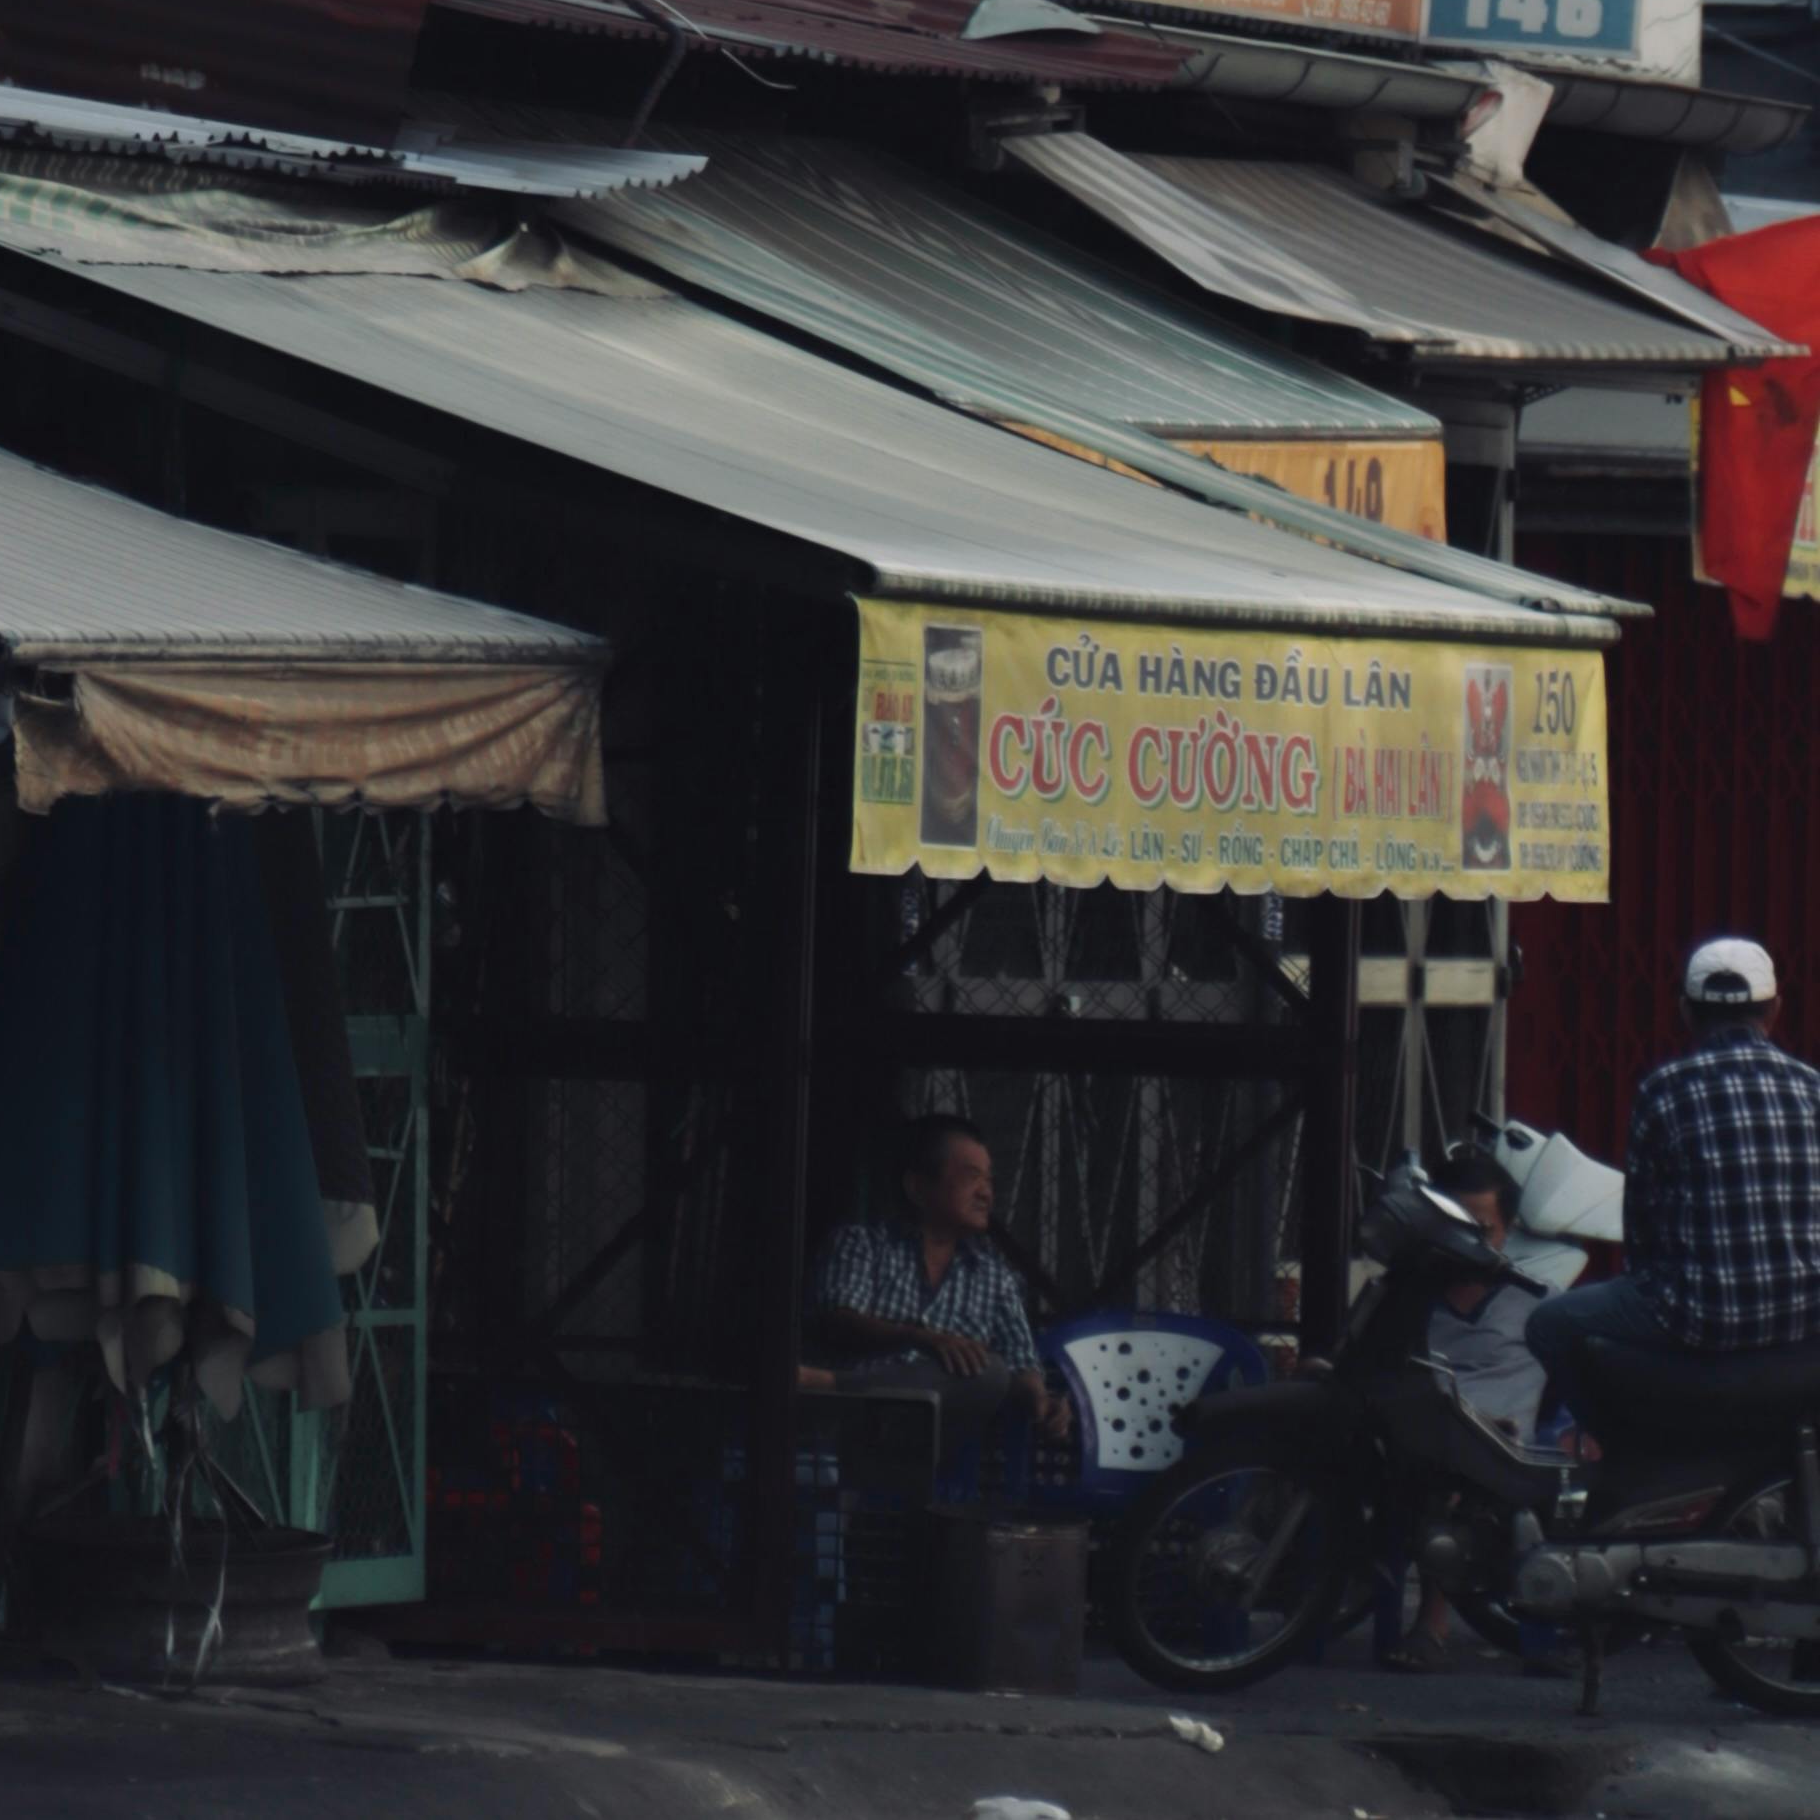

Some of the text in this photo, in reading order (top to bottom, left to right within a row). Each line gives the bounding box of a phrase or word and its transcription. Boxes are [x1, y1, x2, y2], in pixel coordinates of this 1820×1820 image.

[1046, 633, 1412, 710] CỬA HÀNG ĐẦU LÂN
[1532, 668, 1577, 736] 150
[988, 695, 1110, 801] CÚC
[1127, 708, 1318, 811] CƯỜNG
[1130, 821, 1165, 863] LÂN
